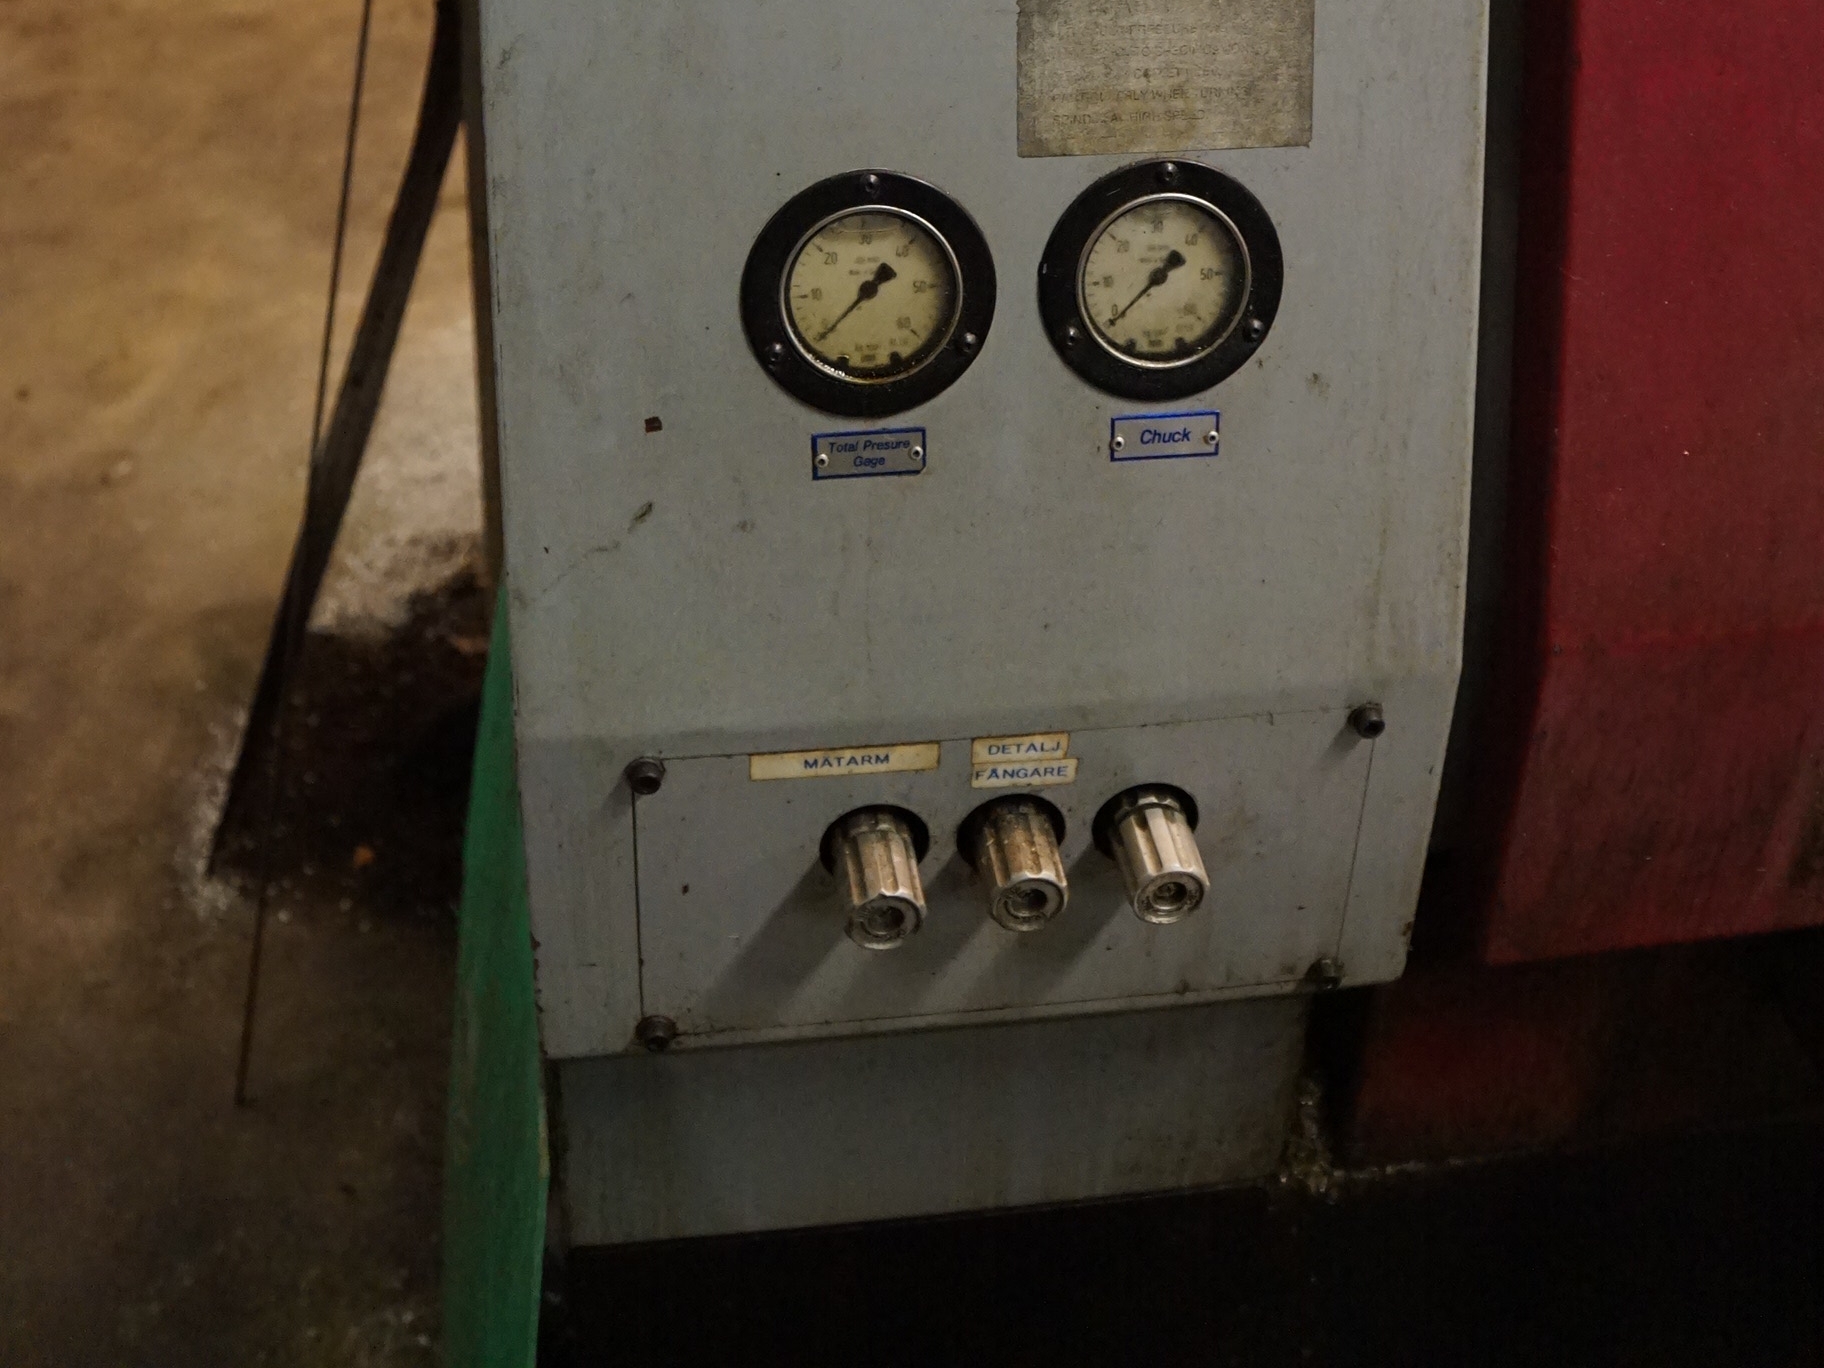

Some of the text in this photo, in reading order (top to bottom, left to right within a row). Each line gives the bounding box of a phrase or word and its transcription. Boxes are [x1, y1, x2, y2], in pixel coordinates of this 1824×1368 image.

[823, 251, 839, 266] 20
[1199, 267, 1214, 281] 50
[1140, 427, 1192, 445] Chuck
[829, 438, 911, 454] Total Presure
[987, 741, 1061, 756] DETALJ
